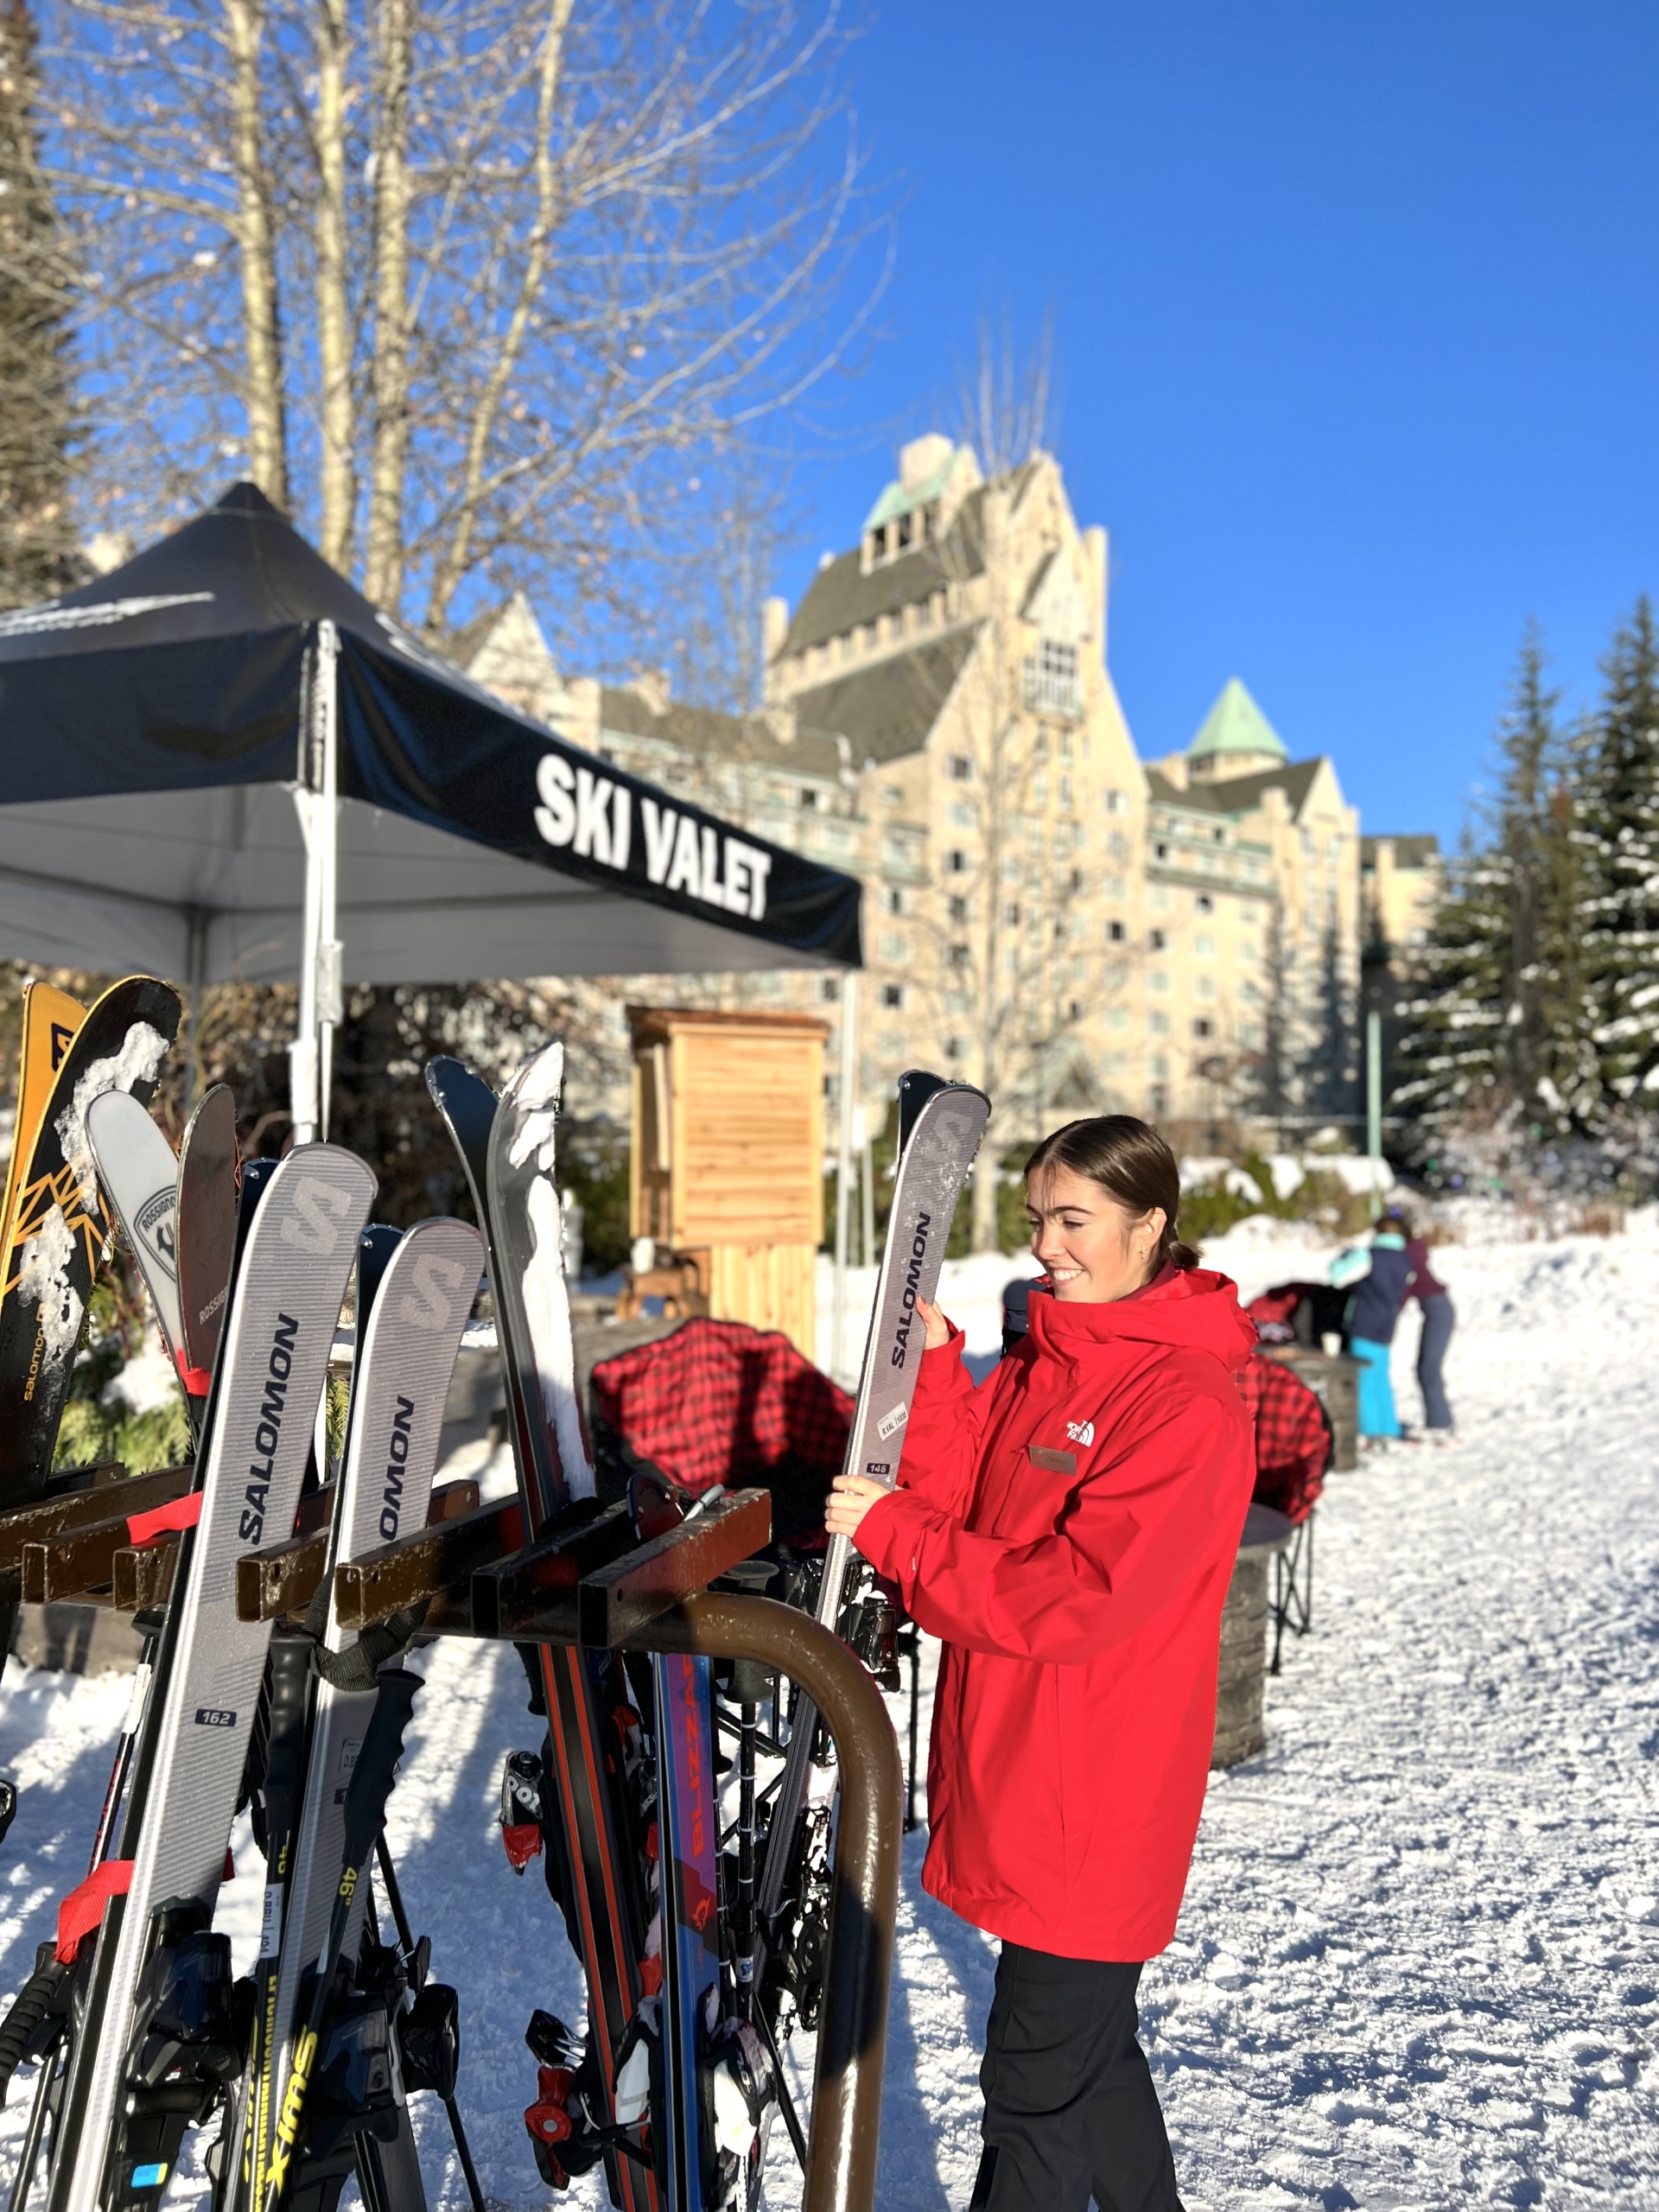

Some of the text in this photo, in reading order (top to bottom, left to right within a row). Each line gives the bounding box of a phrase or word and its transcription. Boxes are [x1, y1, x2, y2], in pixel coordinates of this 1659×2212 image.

[534, 753, 772, 922] SKI VALET
[892, 1211, 931, 1370] SALOMON
[238, 1313, 299, 1546] SALOMON
[378, 1395, 415, 1541] OMON
[202, 1711, 231, 1725] 162
